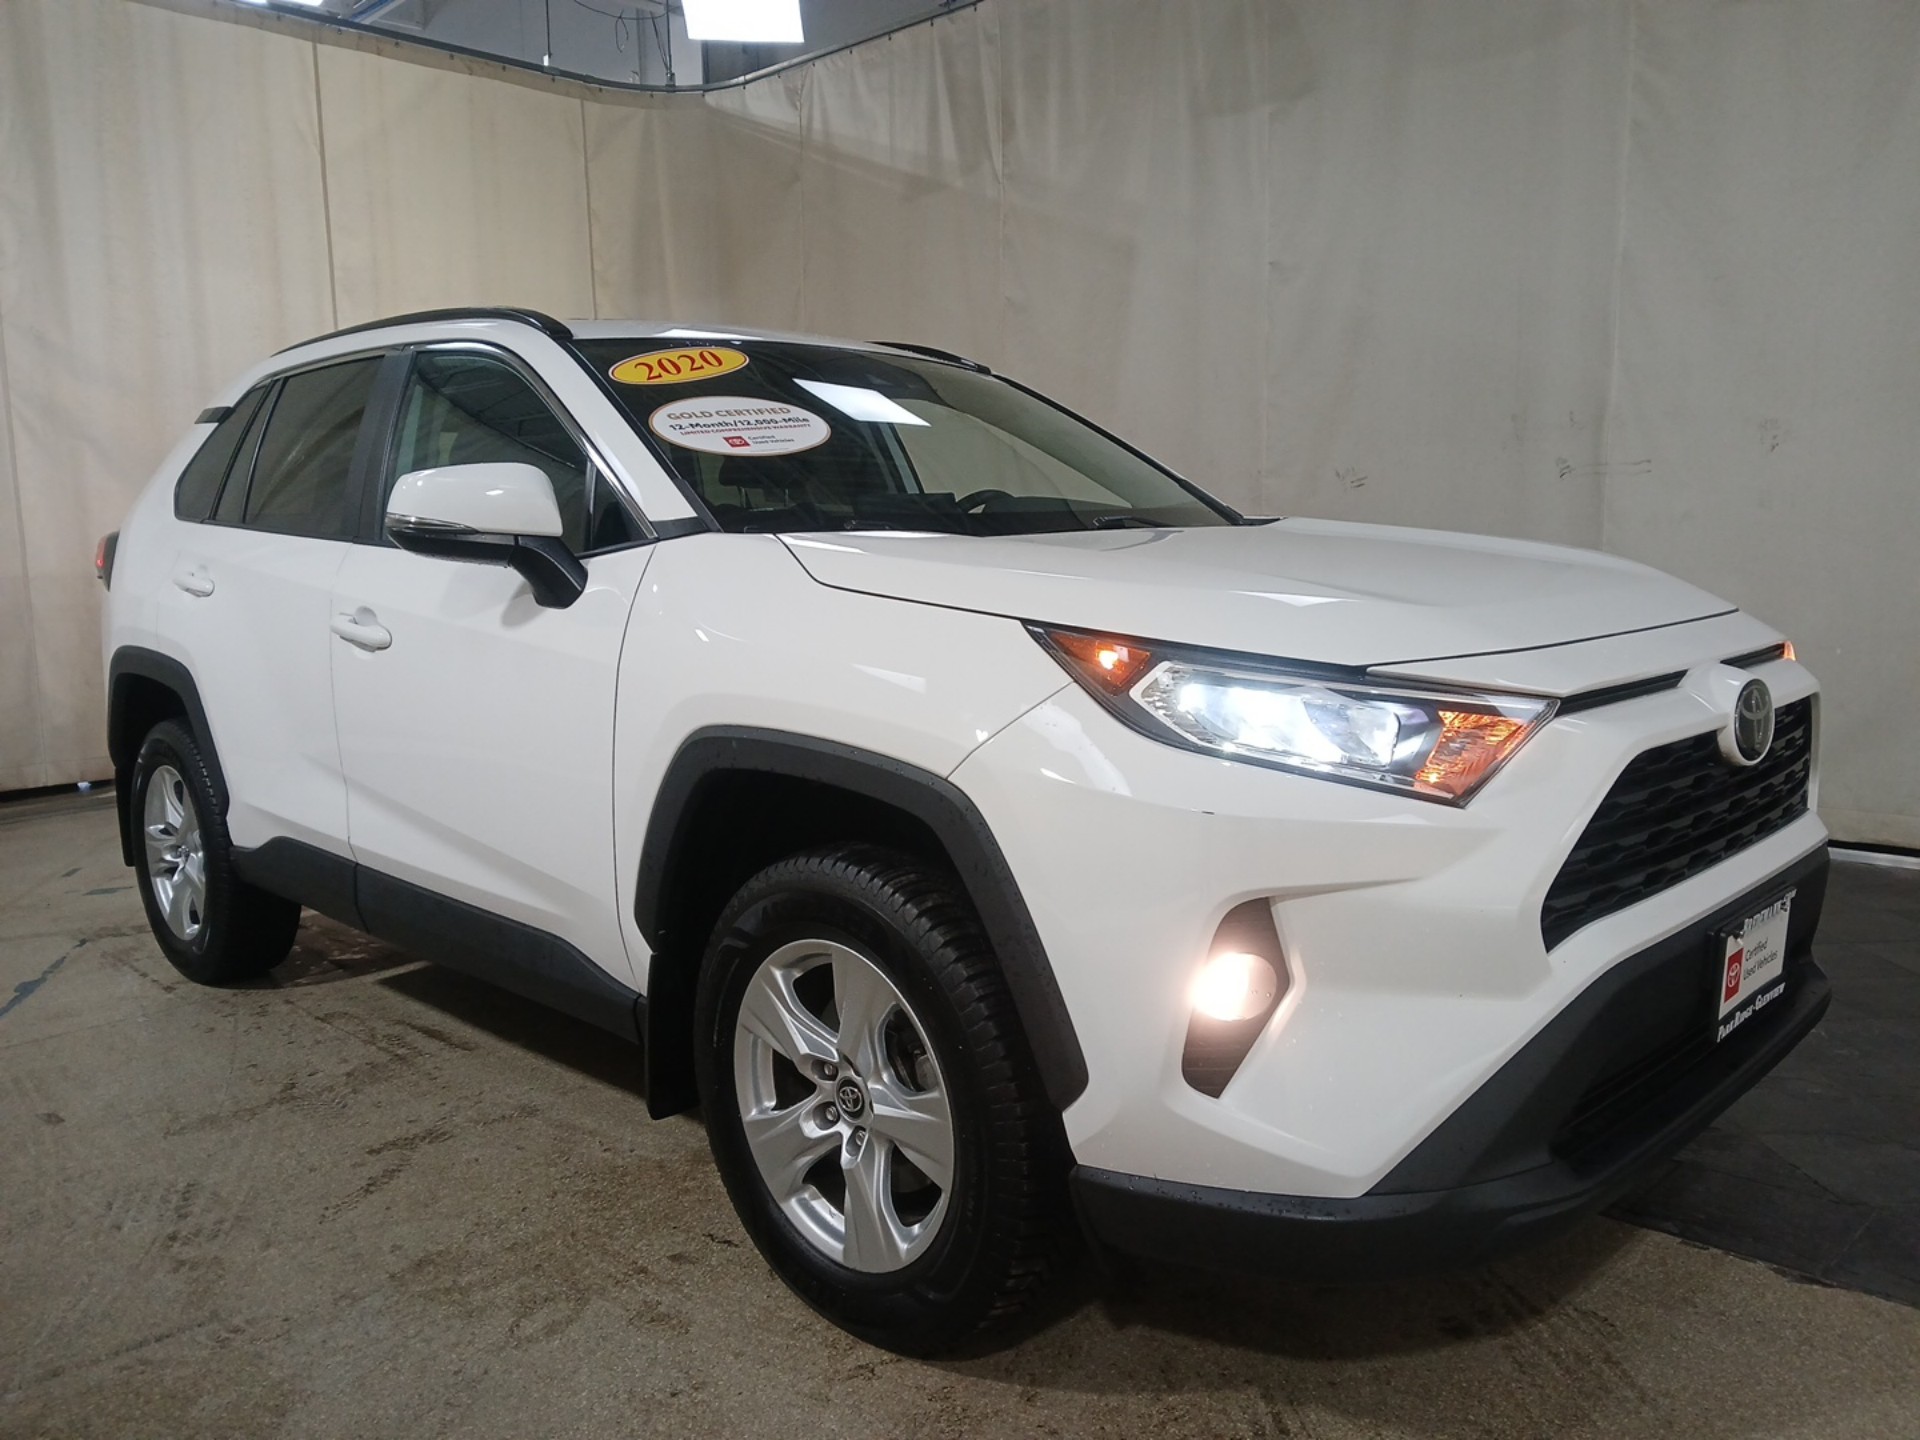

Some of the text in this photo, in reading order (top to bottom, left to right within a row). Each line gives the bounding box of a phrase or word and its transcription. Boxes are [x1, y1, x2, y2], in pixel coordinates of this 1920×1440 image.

[634, 350, 723, 381] 2020
[667, 407, 791, 420] GOLD CERTIFIED
[1745, 936, 1768, 962] Certified
[1743, 949, 1778, 981] Used Vehicles
